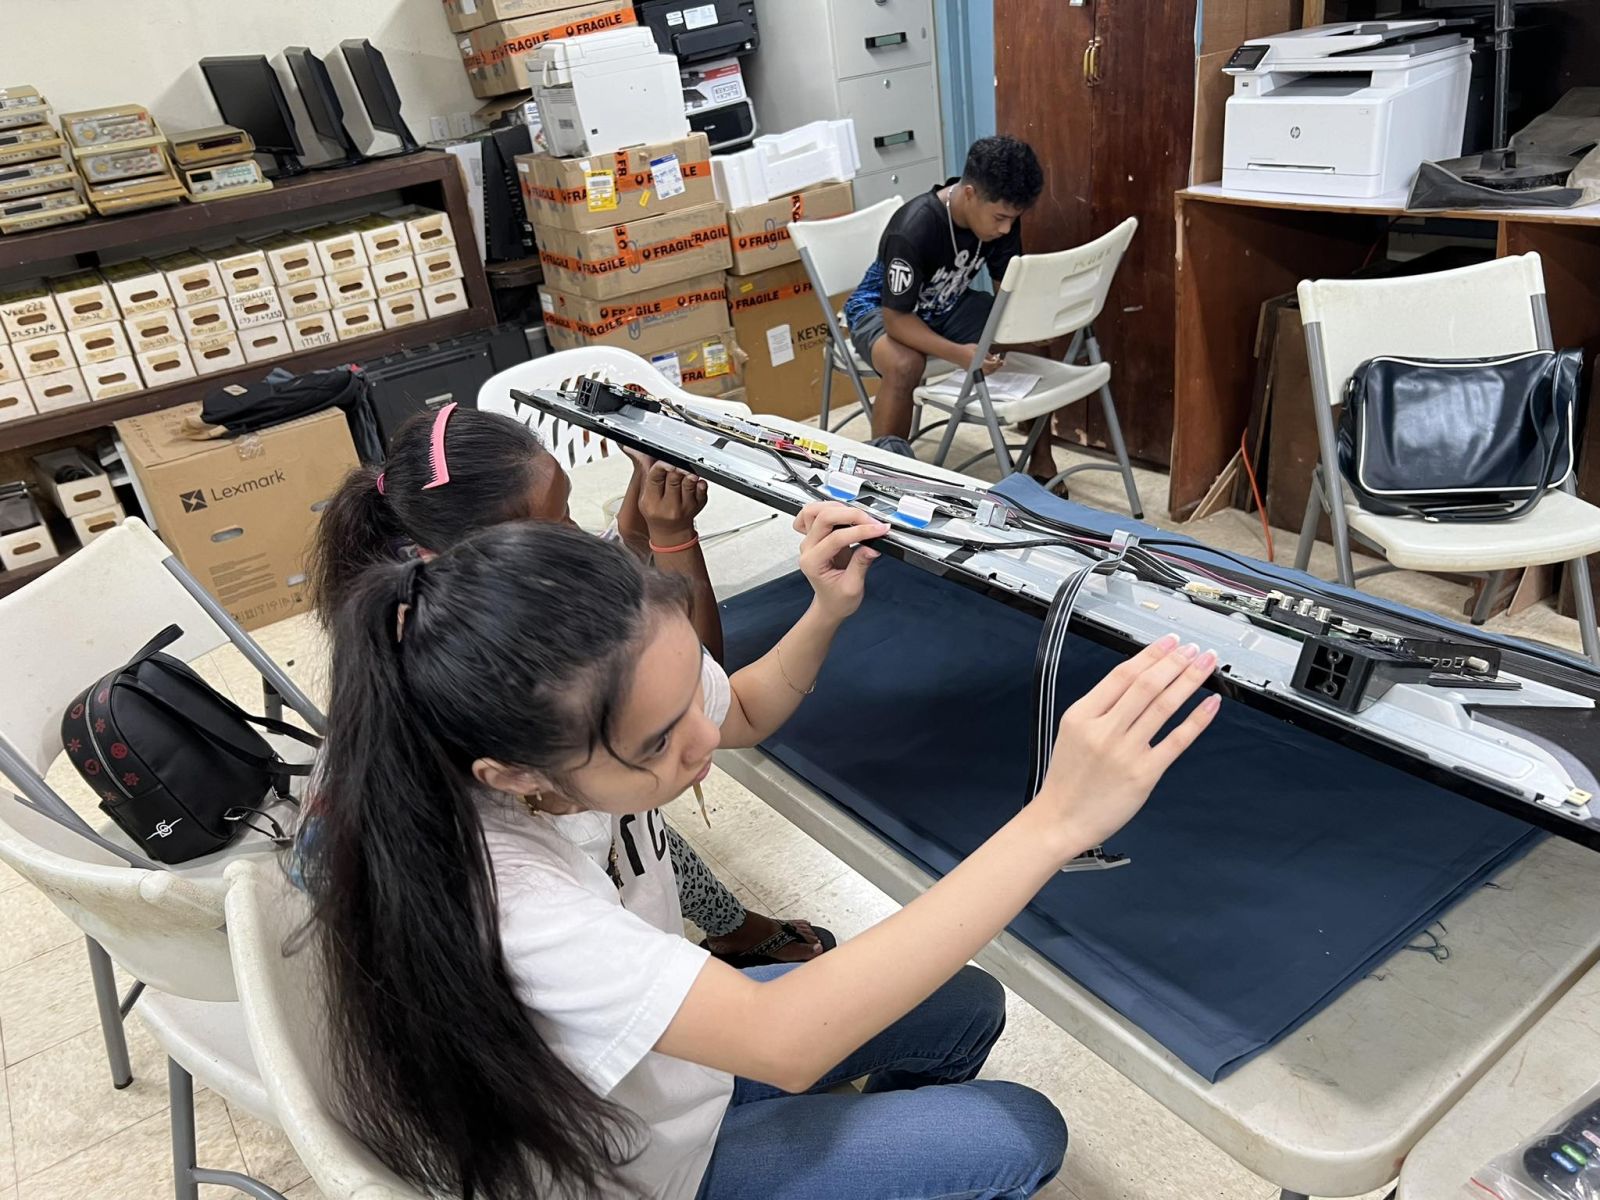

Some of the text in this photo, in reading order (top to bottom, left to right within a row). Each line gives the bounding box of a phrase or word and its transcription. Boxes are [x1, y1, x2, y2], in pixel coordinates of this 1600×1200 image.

[576, 13, 622, 35] FRAGILE
[691, 227, 728, 244] FRAGIL
[654, 239, 694, 258] FRAGIL
[582, 257, 627, 275] FRAGILE
[688, 290, 727, 305] FRAGIL
[735, 290, 780, 310] FRAGILE
[797, 323, 828, 342] KEYS
[210, 469, 286, 501] Lexmark
